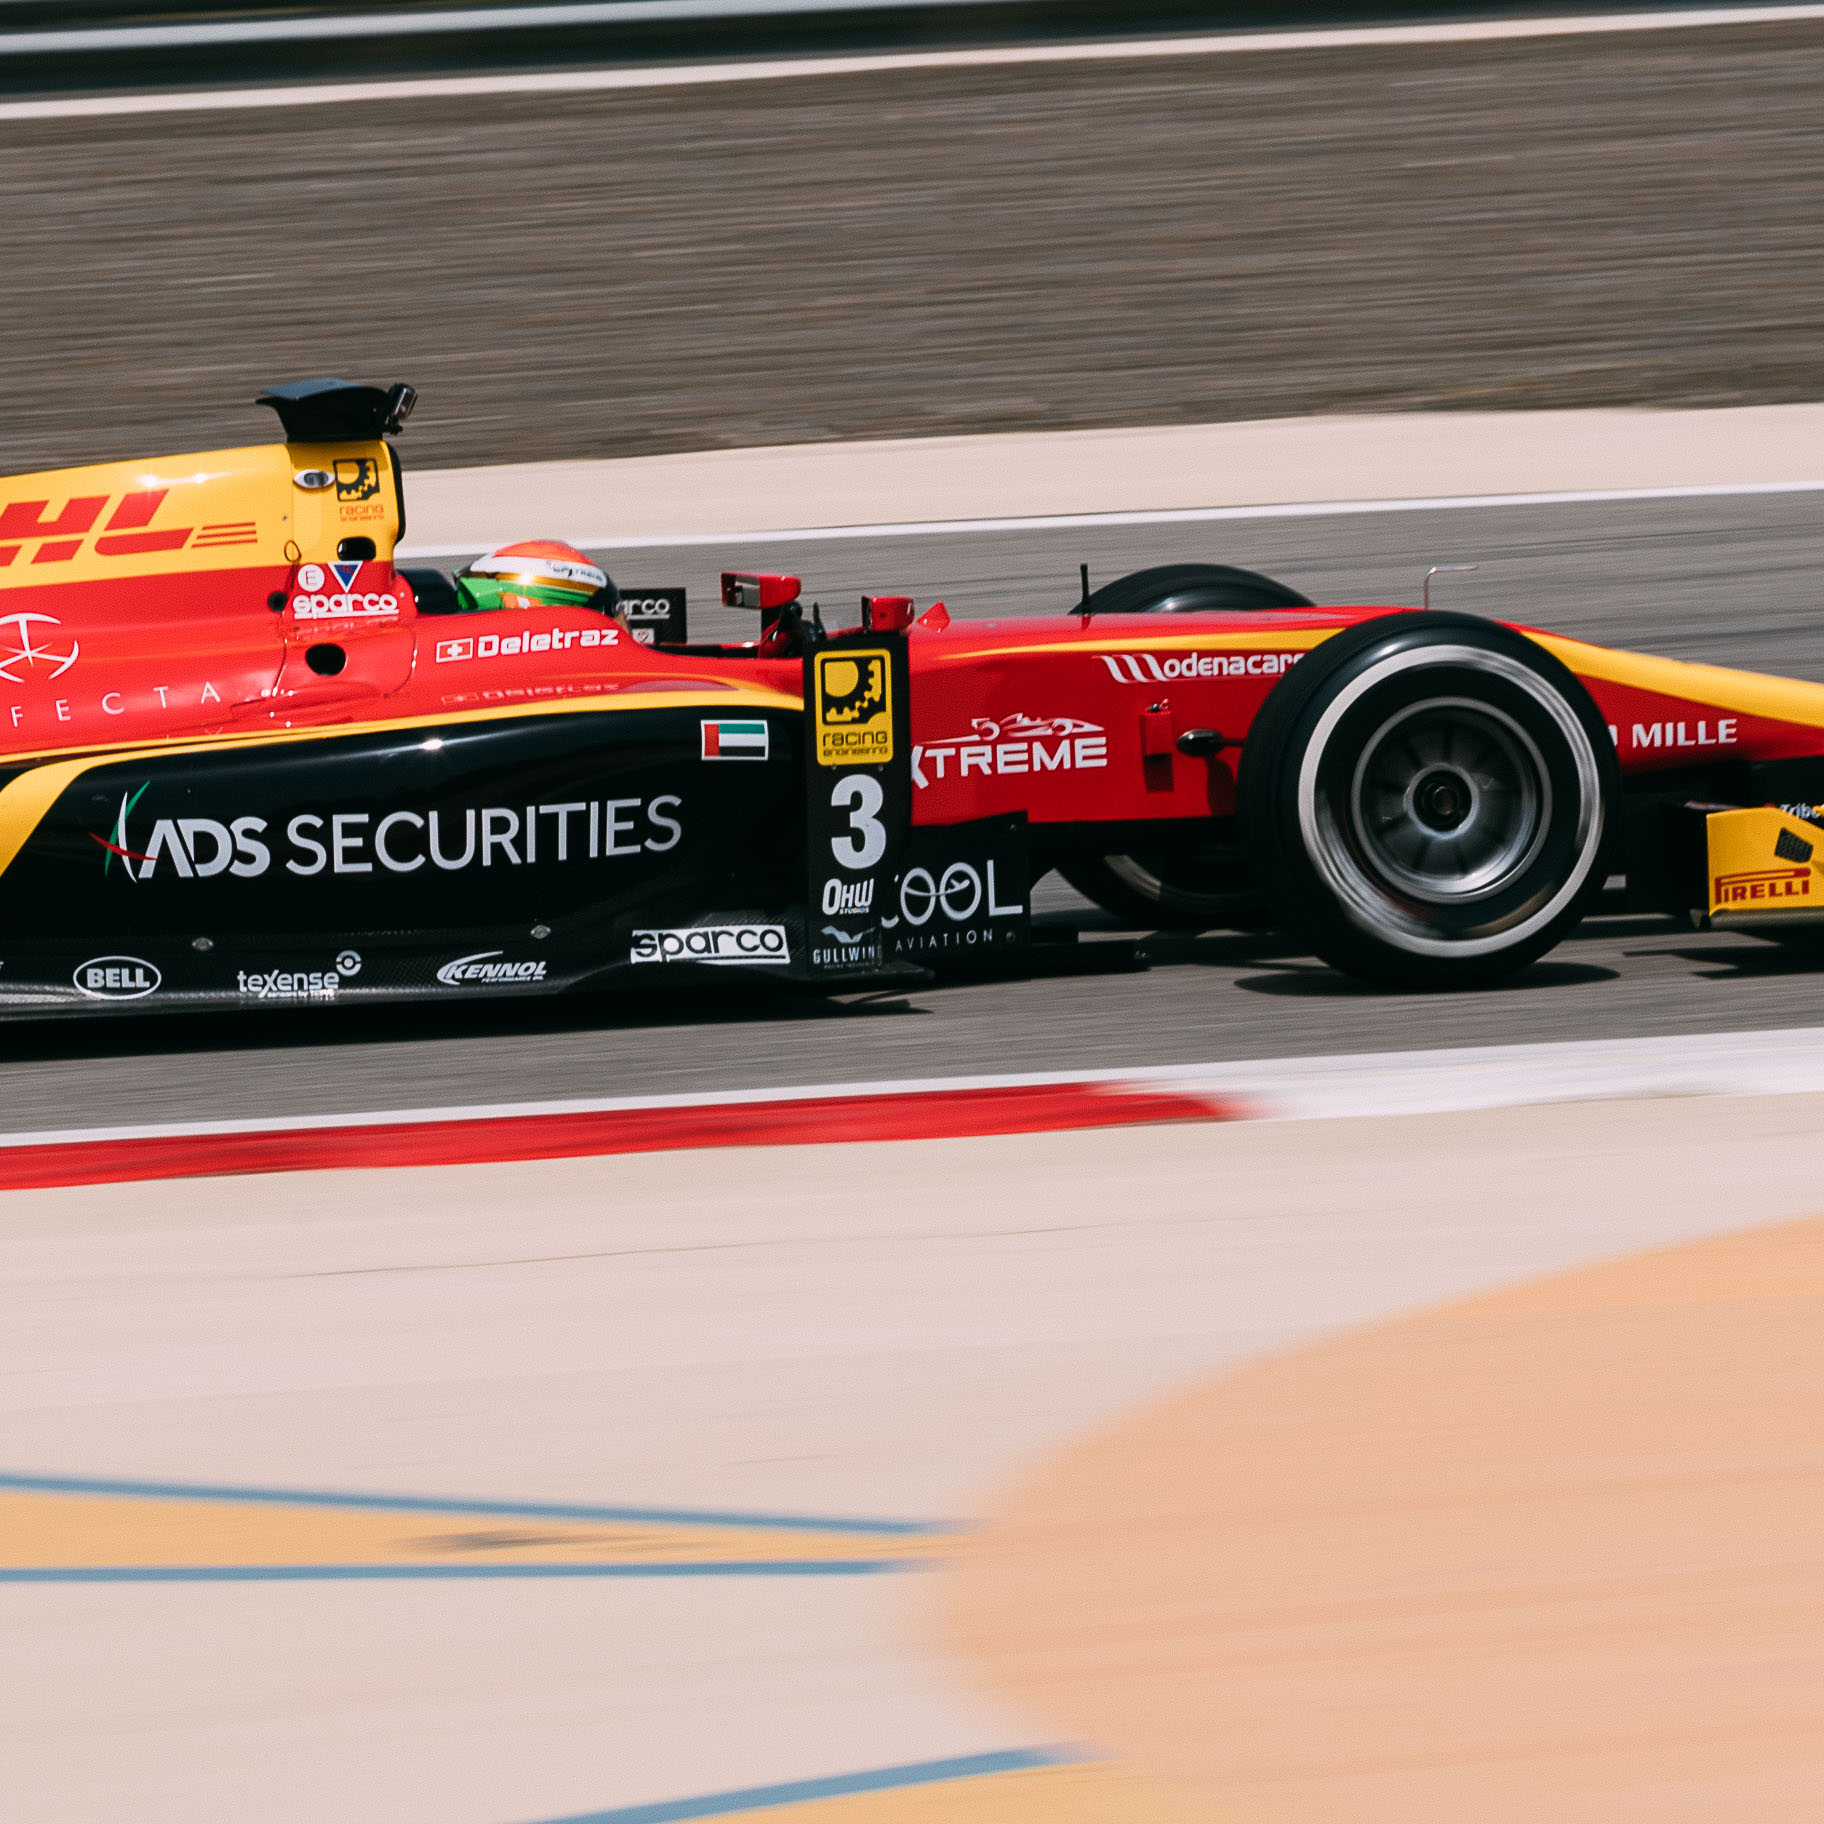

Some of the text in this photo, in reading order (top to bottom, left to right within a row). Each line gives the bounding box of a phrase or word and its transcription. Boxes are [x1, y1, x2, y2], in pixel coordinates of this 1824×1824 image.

[305, 570, 317, 585] E
[293, 593, 399, 619] sparco
[478, 628, 619, 658] Deletraz
[823, 731, 888, 747] racing
[1632, 718, 1737, 748] MILLE
[831, 774, 886, 870] 3
[139, 795, 682, 878] ADS SECURITIES
[1715, 868, 1811, 905] PIRELLI
[632, 929, 784, 962] sparco
[895, 928, 993, 952] AVIATION
[813, 945, 876, 964] GULLWIN
[87, 968, 150, 989] BELL
[237, 969, 339, 998] texense
[445, 961, 547, 979] KENNOL
